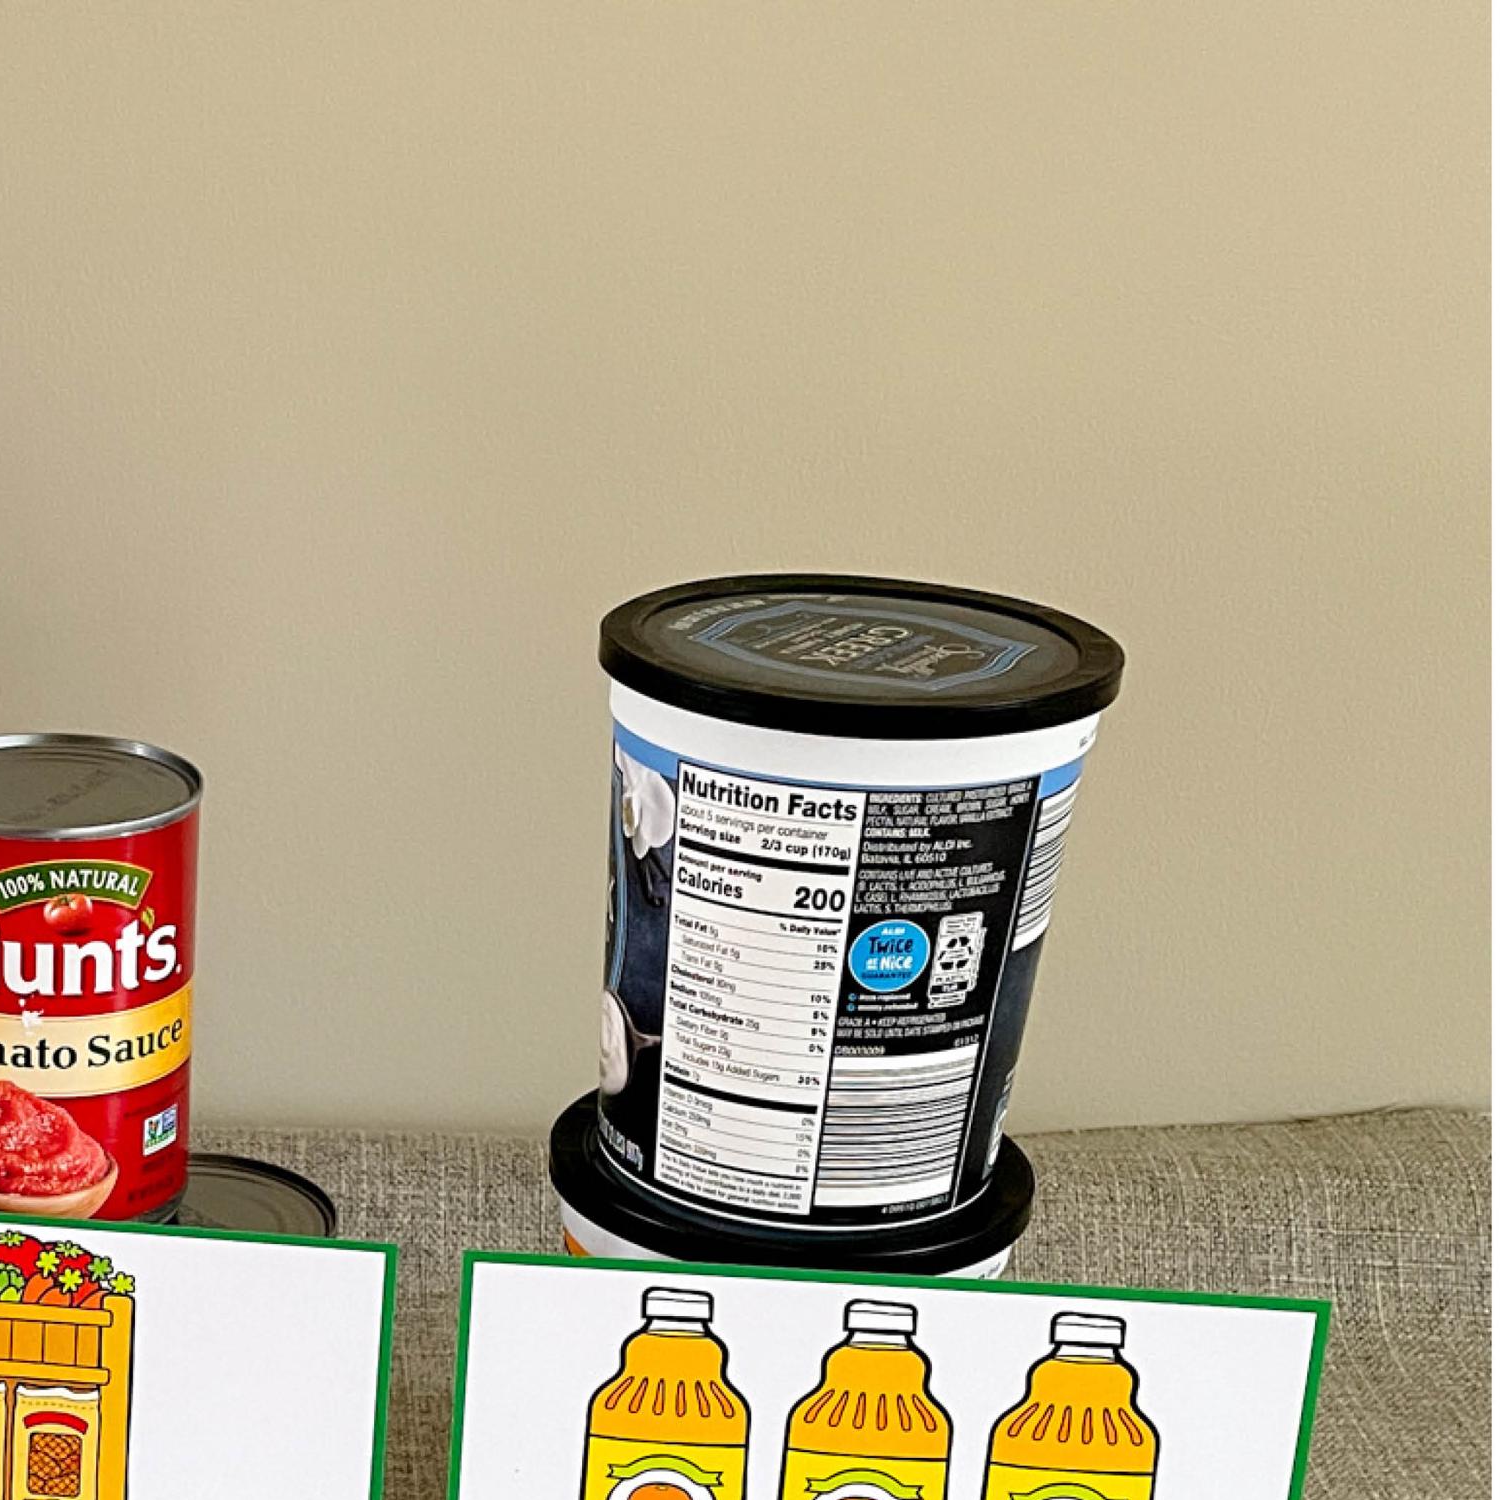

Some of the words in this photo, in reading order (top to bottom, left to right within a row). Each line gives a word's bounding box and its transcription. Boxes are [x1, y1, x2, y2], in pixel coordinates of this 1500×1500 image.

[682, 770, 779, 813] Nutrition
[788, 793, 858, 821] Facts
[757, 823, 775, 836] per
[760, 838, 783, 851] 2/3
[785, 843, 809, 856] cup
[812, 845, 851, 860] (170g)
[49, 869, 140, 898] NATURAL
[677, 866, 743, 899] Calories
[793, 886, 846, 912] 200
[87, 1016, 184, 1068] Sauce
